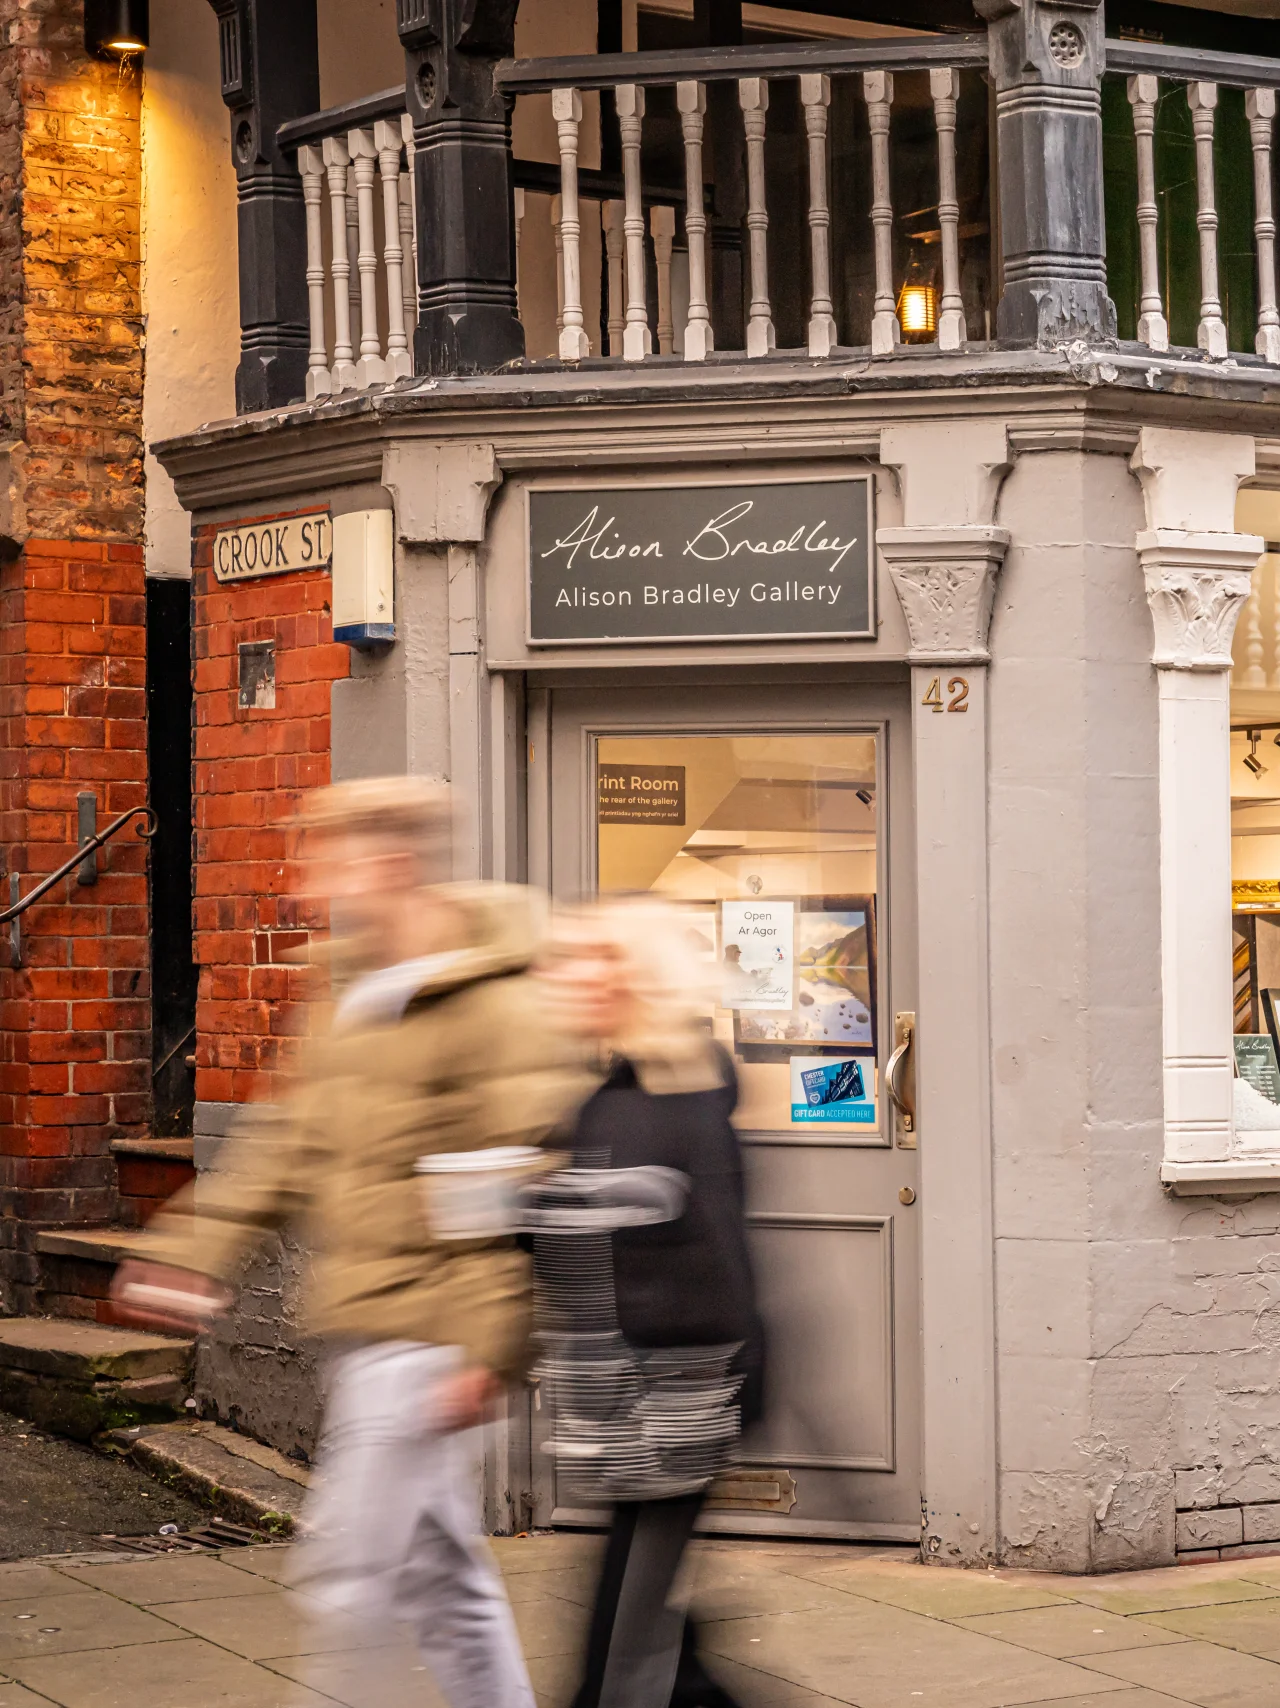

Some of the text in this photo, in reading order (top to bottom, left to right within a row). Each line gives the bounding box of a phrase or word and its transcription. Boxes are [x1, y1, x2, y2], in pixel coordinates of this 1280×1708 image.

[541, 500, 857, 572] Alison Bradley
[219, 525, 289, 574] CROOK
[555, 581, 842, 607] Alison Bradley Gallery
[921, 675, 969, 713] 42
[598, 774, 679, 791] rint Room
[628, 796, 636, 804] of
[637, 797, 650, 805] the
[652, 798, 678, 807] gallery
[744, 911, 771, 921] Open
[738, 926, 777, 937] Ar Agor
[794, 1109, 807, 1117] GIFT
[808, 1109, 825, 1117] CARD
[826, 1110, 855, 1118] ACCEPTED
